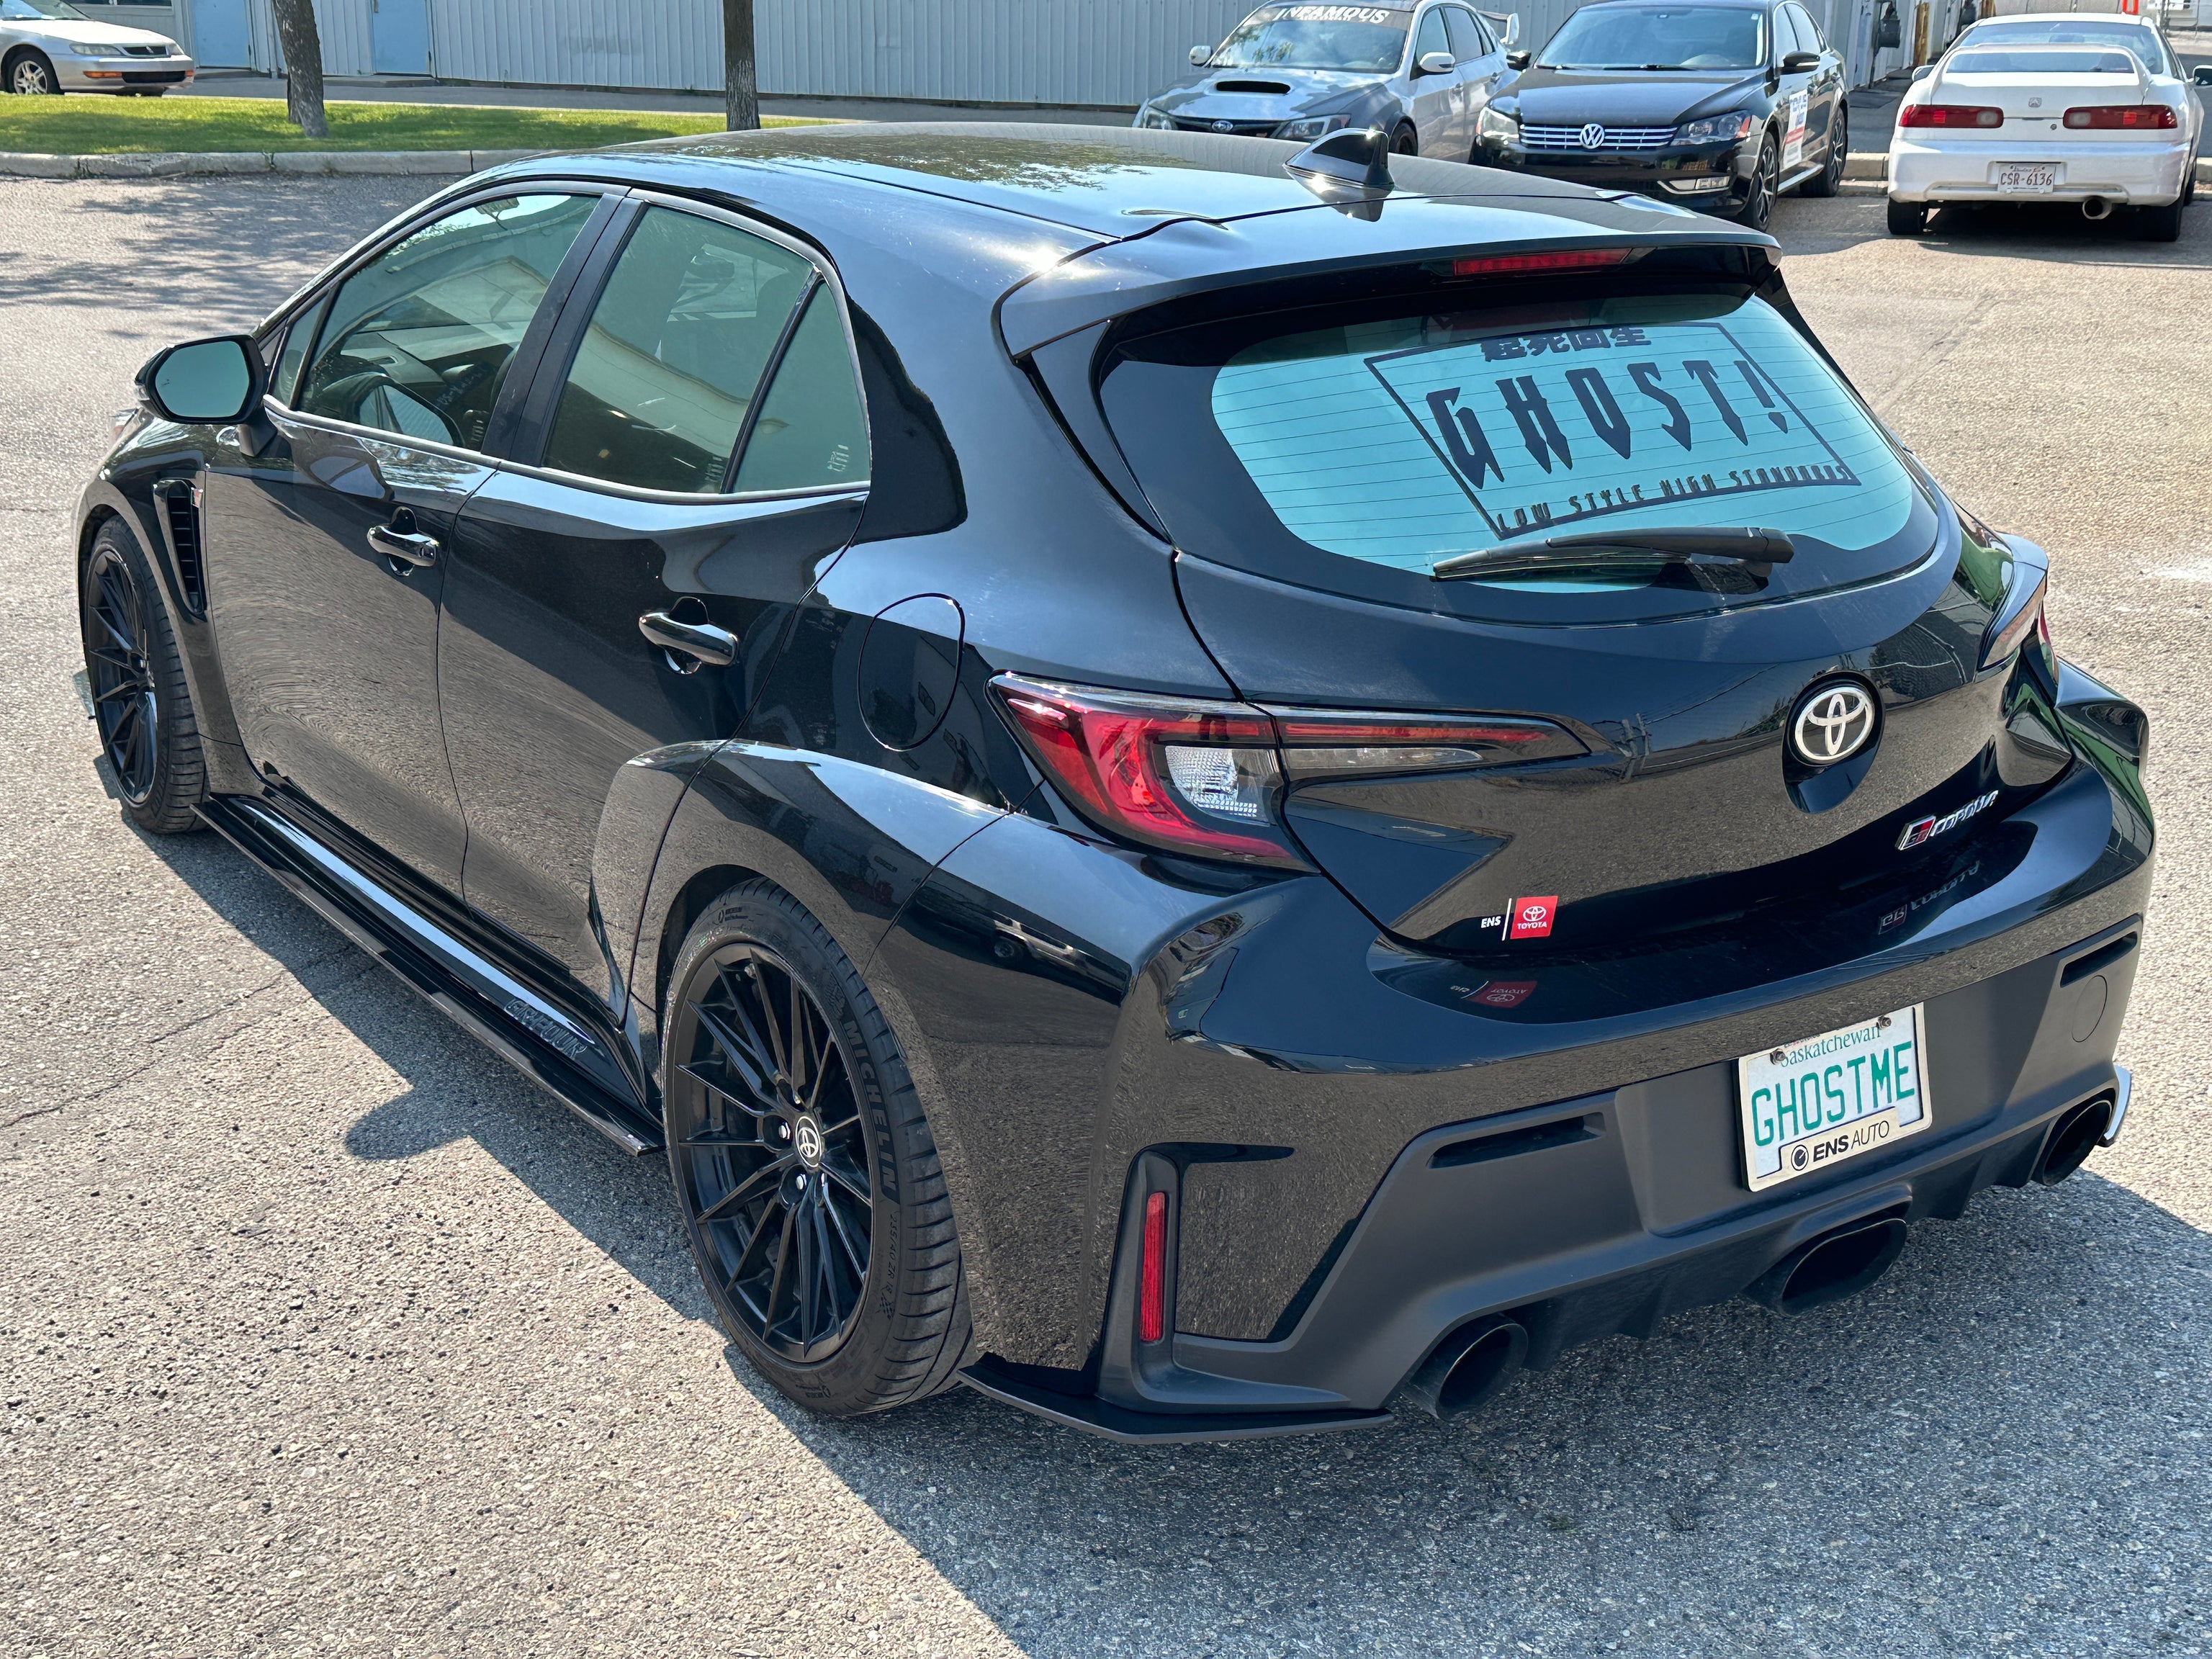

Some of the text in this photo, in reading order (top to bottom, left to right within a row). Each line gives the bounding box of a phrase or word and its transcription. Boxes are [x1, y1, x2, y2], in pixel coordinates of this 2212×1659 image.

[1272, 6, 1390, 24] INFAMOUS
[2000, 172, 2053, 186] CSR-6136
[1426, 360, 1789, 490] GHOST!
[1496, 502, 1552, 534] LOW
[1568, 484, 1645, 514] STYLE
[1659, 473, 1718, 498] HIGH
[1480, 916, 1502, 929] ENS
[1517, 921, 1548, 930] TOYOTA
[843, 1020, 897, 1192] MICHELIN
[1751, 1040, 1916, 1146] GHOSTME
[1813, 1120, 1890, 1163] ENS AUTO
